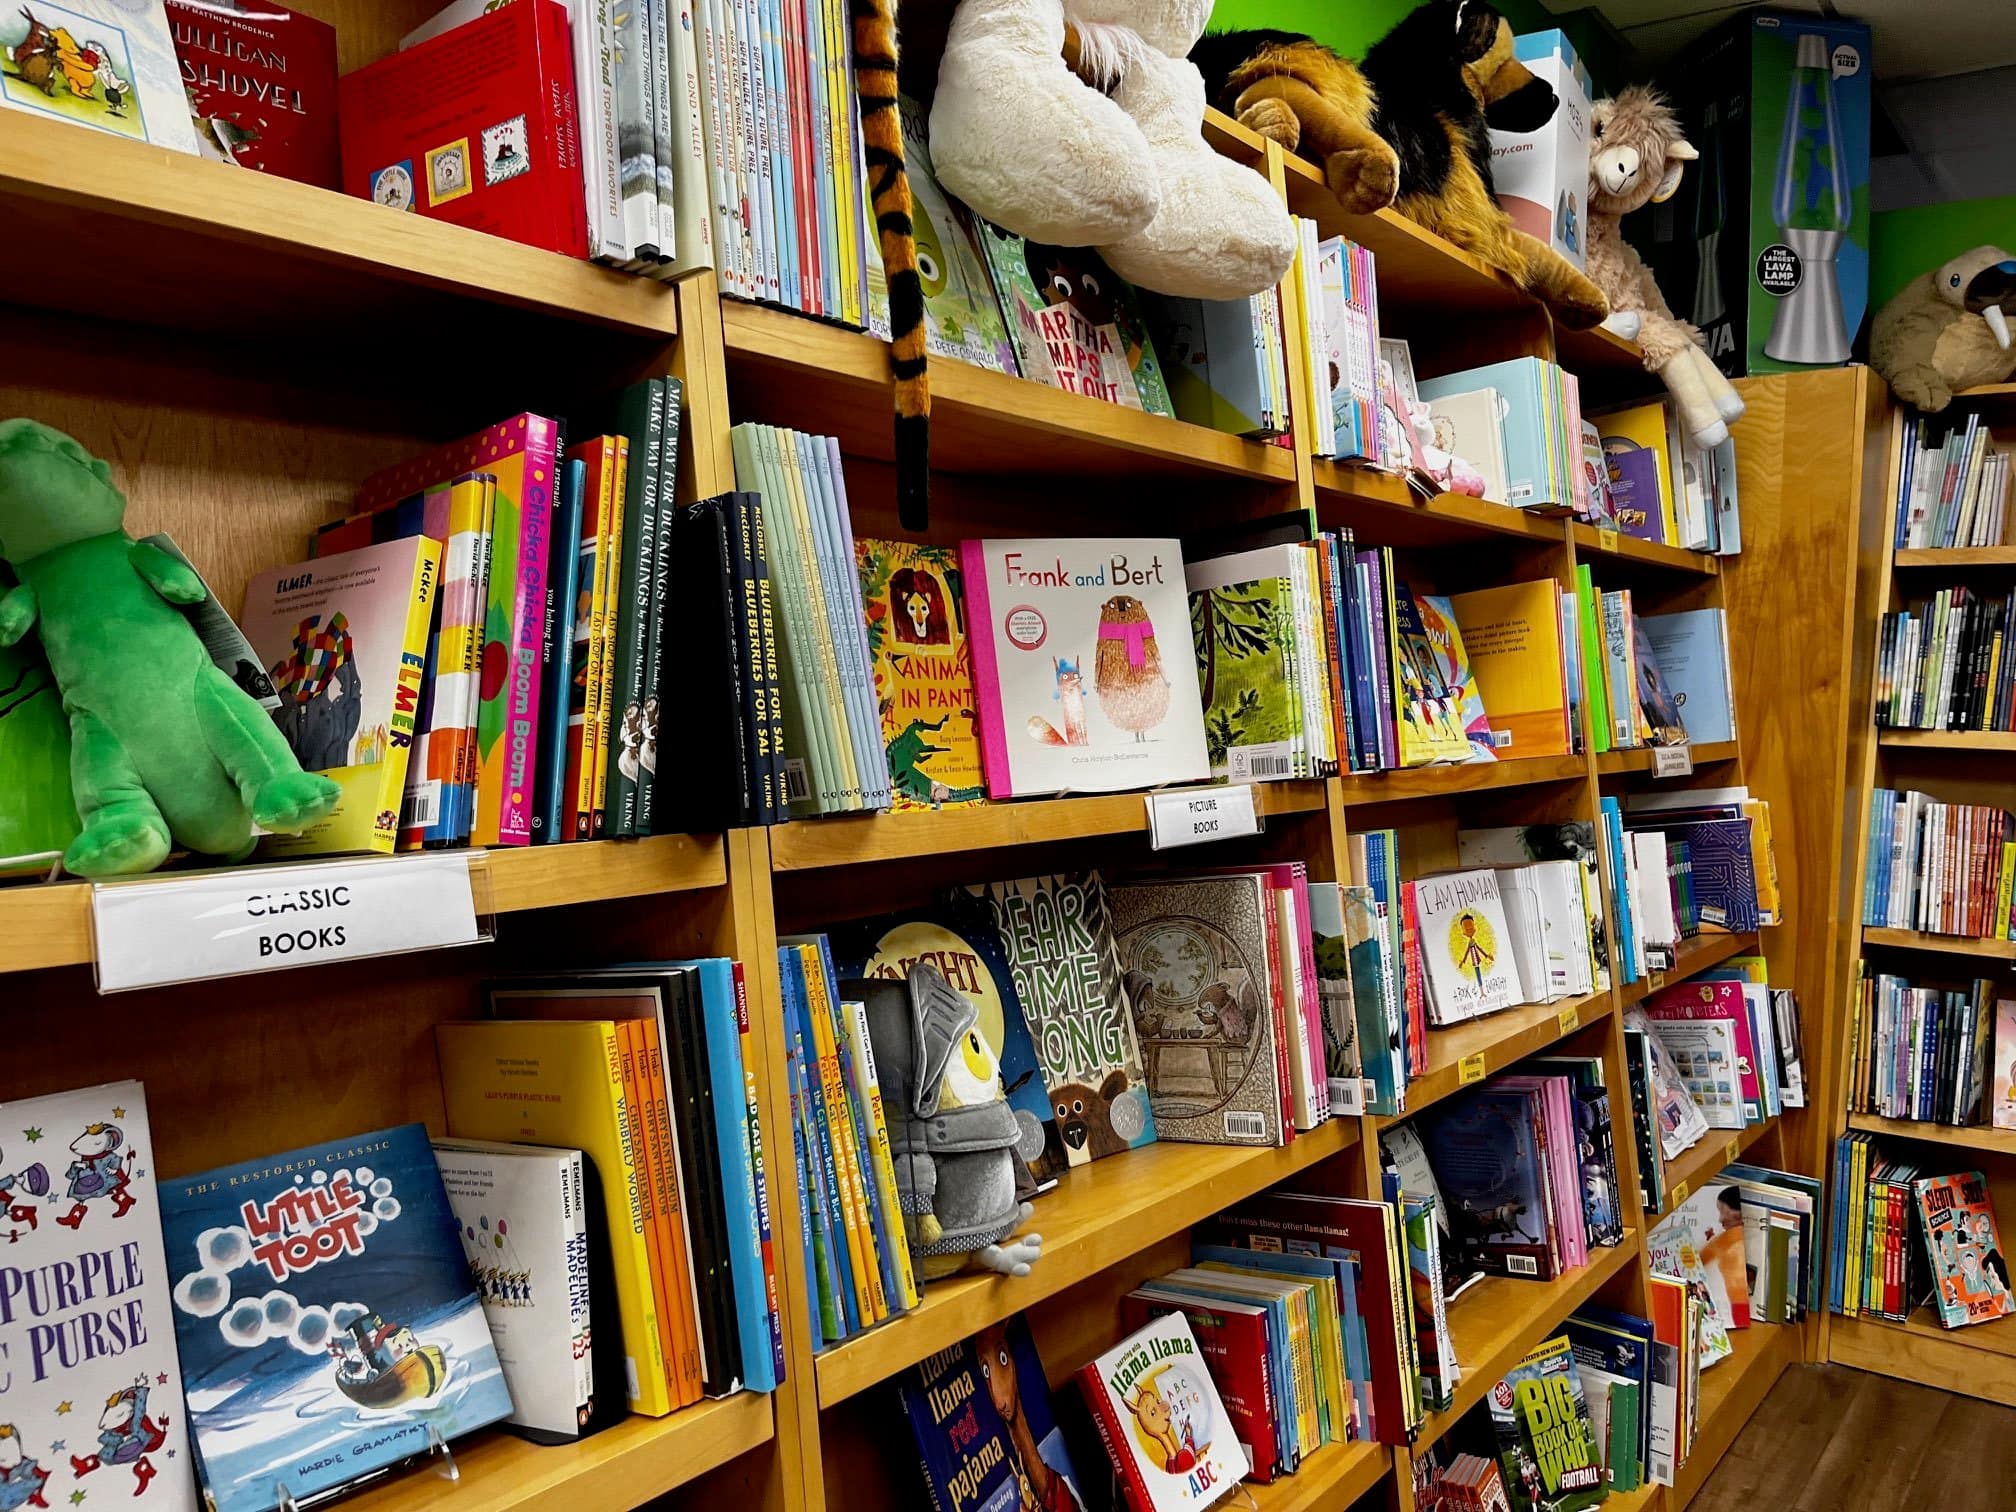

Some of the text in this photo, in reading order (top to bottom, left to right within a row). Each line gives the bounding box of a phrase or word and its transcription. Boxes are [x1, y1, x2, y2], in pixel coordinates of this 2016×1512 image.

[192, 8, 275, 39] MATTHEW BRODERICK
[740, 40, 748, 66] SOFIA
[1834, 53, 1857, 61] ACTUAL
[642, 34, 653, 122] WILD THINGS ARE
[601, 47, 618, 218] Toad STORYBOOK FAVORITES
[687, 73, 702, 161] BOND ALLEY
[745, 111, 753, 148] FUTURE
[712, 104, 724, 169] ILLUSTRATOR
[748, 150, 757, 175] PREZ
[1763, 255, 1796, 263] LARGEST
[1765, 262, 1793, 272] LAVA
[1773, 249, 1787, 257] THE
[1762, 279, 1796, 287] AVAILABLE
[1764, 270, 1794, 281] LAMP
[936, 340, 957, 354] PETE
[1018, 309, 1113, 354] MARTHA
[1050, 341, 1100, 378] MAPS
[1057, 371, 1118, 405] IT OUT
[552, 436, 564, 508] clark arsenault
[632, 389, 664, 698] MAKE WAY FOR DUCKLINGS by Robert McCloskey
[276, 573, 313, 594] ELMER
[418, 559, 434, 604] McKee
[1004, 552, 1164, 588] Frank and Bert
[511, 486, 546, 787] Chicka Chicka Boom Boom
[542, 588, 555, 663] you belong here
[740, 505, 770, 756] McCLOSKEY BLUEBERRIES FOR SAL
[585, 611, 602, 750] LAST STOP ON MARKET STREET
[903, 657, 967, 681] ANIMA
[901, 686, 973, 709] IN PANT
[623, 791, 635, 828] VIKING
[1188, 799, 1218, 813] PICTURE
[1193, 820, 1219, 834] BOOKS
[247, 886, 351, 917] CLASSIC
[1418, 874, 1501, 915] I AM HUMAN
[830, 1054, 840, 1079] Pete
[737, 981, 770, 1231] SHANNON A BAD CASE OF STRIPES
[835, 1081, 845, 1098] the
[838, 1101, 849, 1121] Cat
[871, 1095, 888, 1147] Pete Cat
[606, 1035, 644, 1235] HENKES WEMBERLY WORRIED
[622, 1052, 652, 1221] Henkes CHRYSANTHEMUM
[808, 1122, 817, 1141] Cat
[185, 1140, 391, 1198] THE RESTORED CLASSIC
[813, 1089, 841, 1223] the Cat Bedtime Blues
[847, 1153, 858, 1170] My
[560, 1168, 571, 1220] BEMELMANS
[851, 1172, 864, 1200] White
[242, 1176, 364, 1238] LITTLE
[253, 1212, 363, 1279] TOOT
[1240, 1217, 1259, 1227] miss
[1260, 1218, 1281, 1230] these
[1282, 1221, 1304, 1232] other
[1303, 1223, 1324, 1235] llama
[1323, 1225, 1349, 1237] llamas!
[1648, 1247, 1670, 1269] you
[0, 1240, 145, 1326] PURPLE
[26, 1298, 148, 1384] PURSE
[1110, 1336, 1194, 1398] llama llama
[1179, 1400, 1186, 1411] E
[1495, 1384, 1508, 1398] 101
[1519, 1375, 1577, 1436] BIG
[298, 1421, 429, 1477] HARDIE GRAMATKY
[949, 1409, 979, 1455] red
[1093, 1412, 1123, 1475] LLAMA LLAMA
[1532, 1418, 1583, 1456] BOOK OF
[947, 1435, 1005, 1512] pajama
[1188, 1460, 1218, 1499] ABC
[1537, 1435, 1590, 1496] WHO
[1561, 1466, 1599, 1489] FOOTBALL
